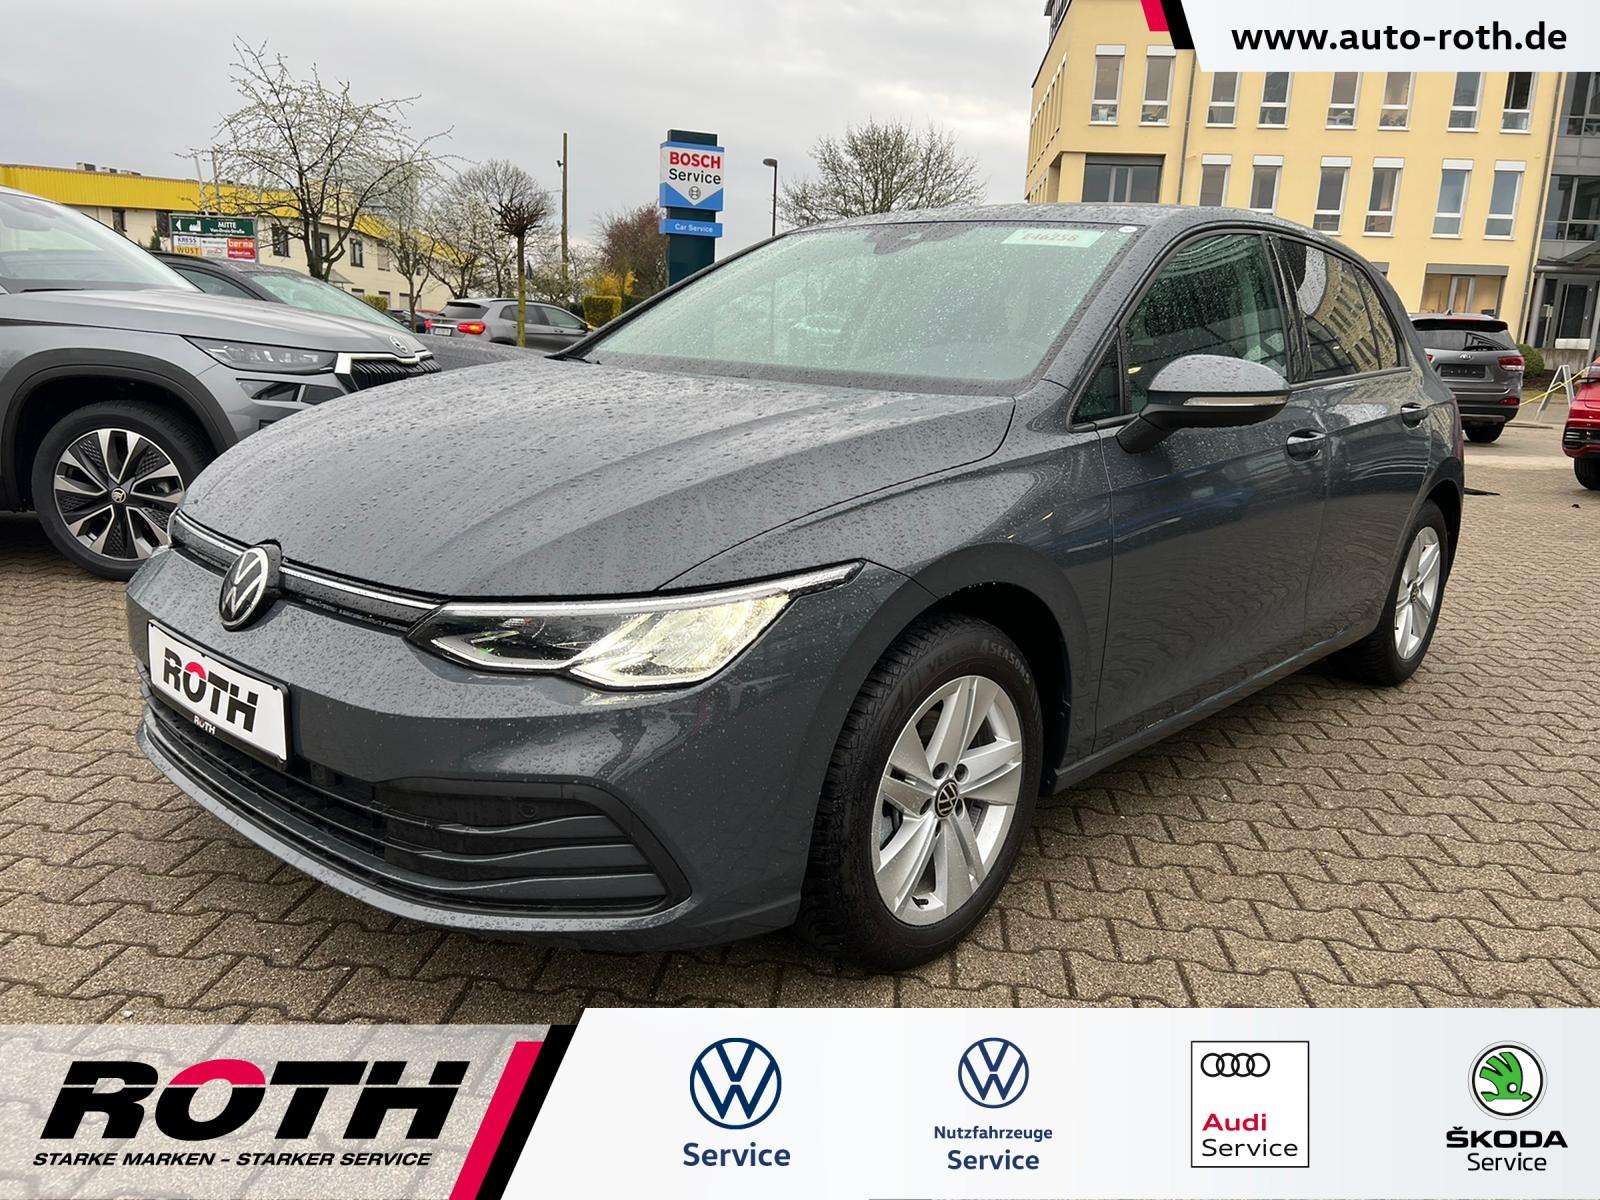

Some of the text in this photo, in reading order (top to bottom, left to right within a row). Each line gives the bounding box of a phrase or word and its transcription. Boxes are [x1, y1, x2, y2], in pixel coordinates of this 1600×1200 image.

[669, 151, 721, 169] BOSCH
[668, 168, 721, 184] Service
[674, 223, 713, 233] Car Service
[163, 646, 259, 733] ROTH
[193, 714, 216, 736] ROTH
